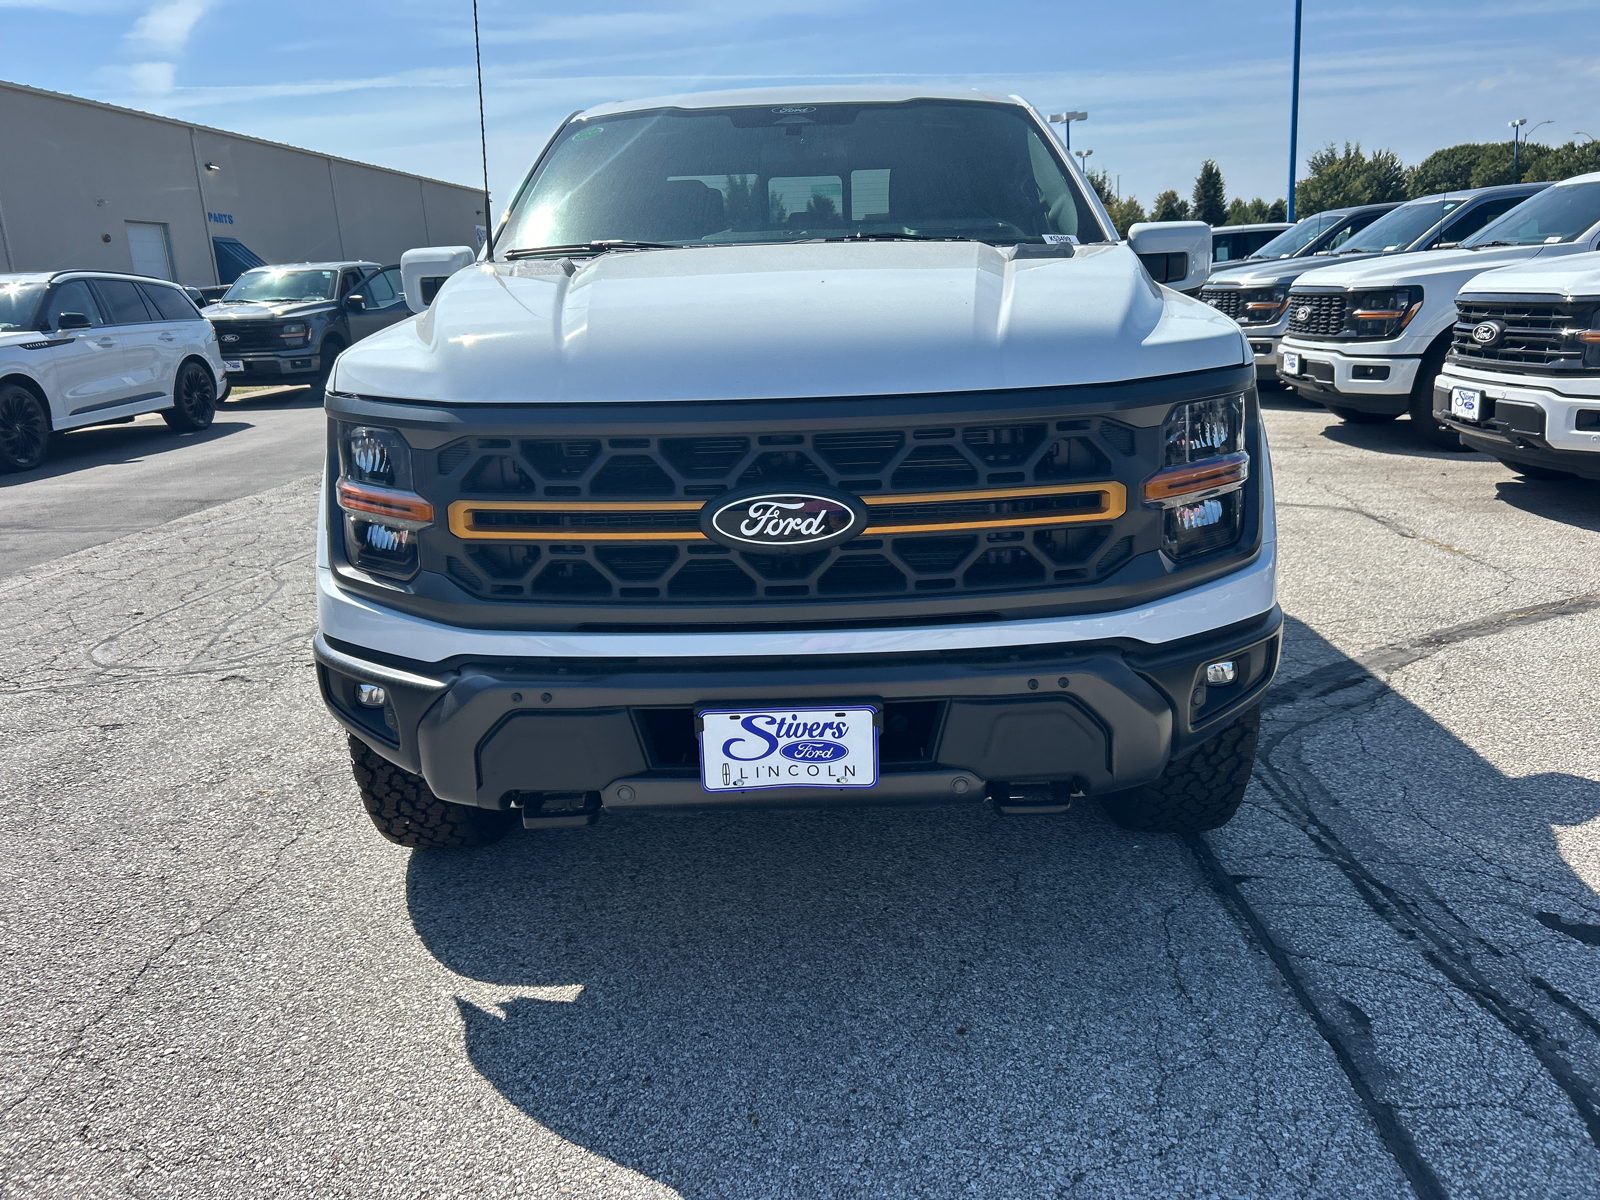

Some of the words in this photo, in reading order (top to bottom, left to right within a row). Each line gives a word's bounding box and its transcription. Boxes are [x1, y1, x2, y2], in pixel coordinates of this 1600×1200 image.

[779, 105, 809, 114] Ford
[207, 211, 234, 225] PARTS
[1476, 326, 1492, 340] Ford
[740, 501, 827, 536] Ford
[722, 713, 850, 762] Stivers
[794, 743, 834, 759] Ford
[740, 764, 856, 779] LINCOLN
